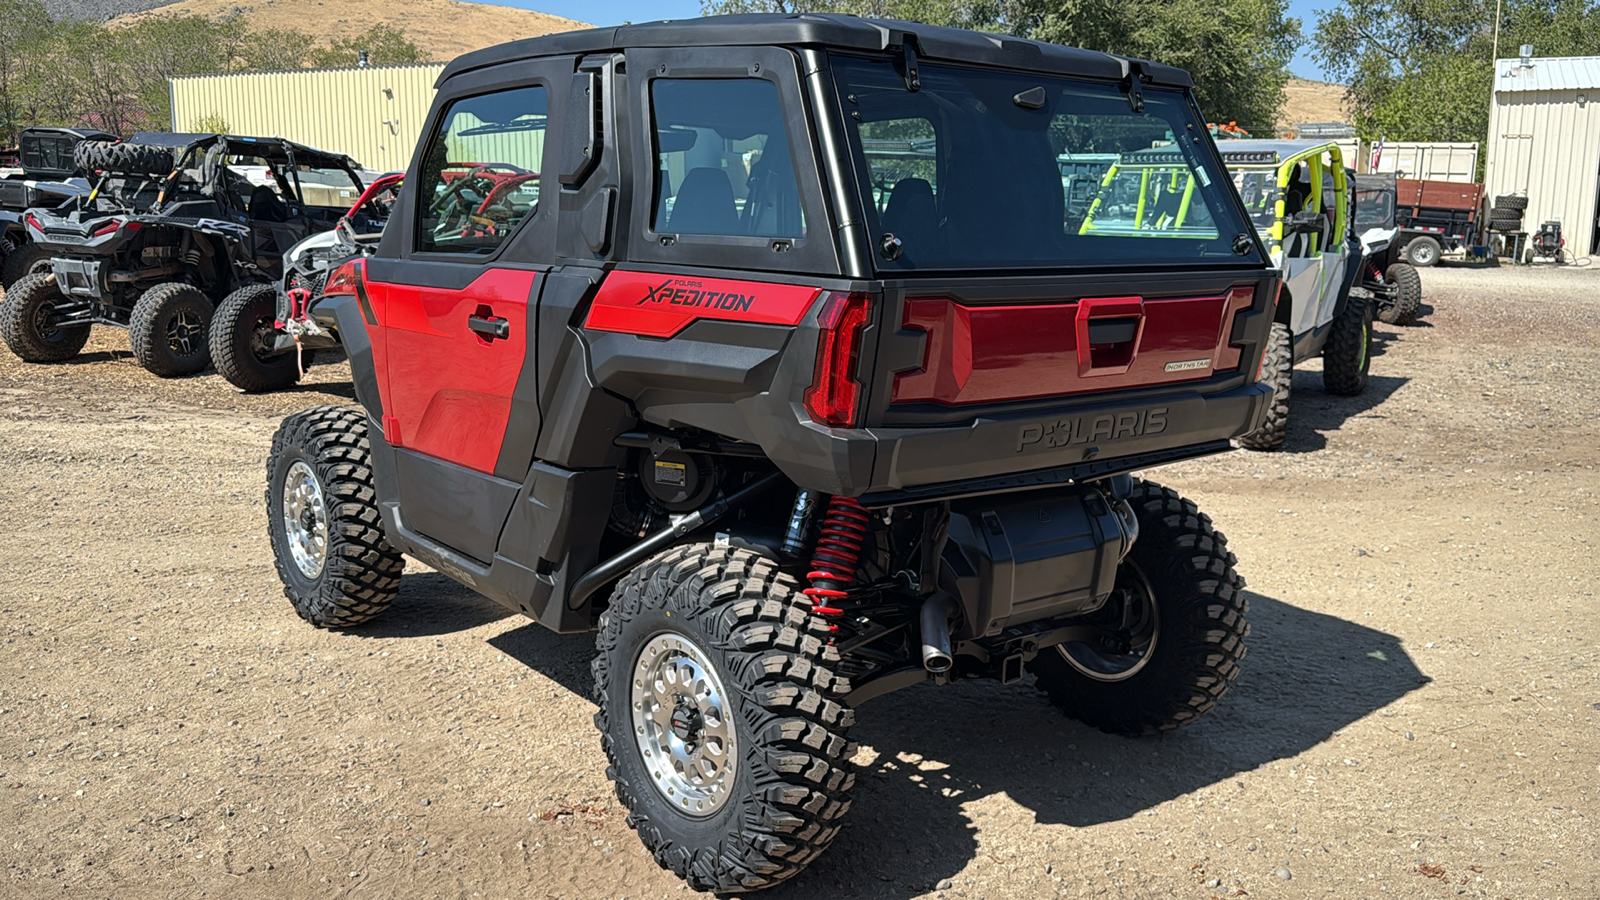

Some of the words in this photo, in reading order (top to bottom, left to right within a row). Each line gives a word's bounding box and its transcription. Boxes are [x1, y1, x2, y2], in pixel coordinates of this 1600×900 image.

[197, 218, 251, 237] RZR
[234, 259, 258, 269] XP
[674, 280, 703, 288] POLARIS
[637, 279, 755, 312] XPEDITION
[1167, 361, 1210, 370] NORTHSTAR
[1017, 408, 1170, 452] POLARIS
[418, 549, 477, 587] POLARIS
